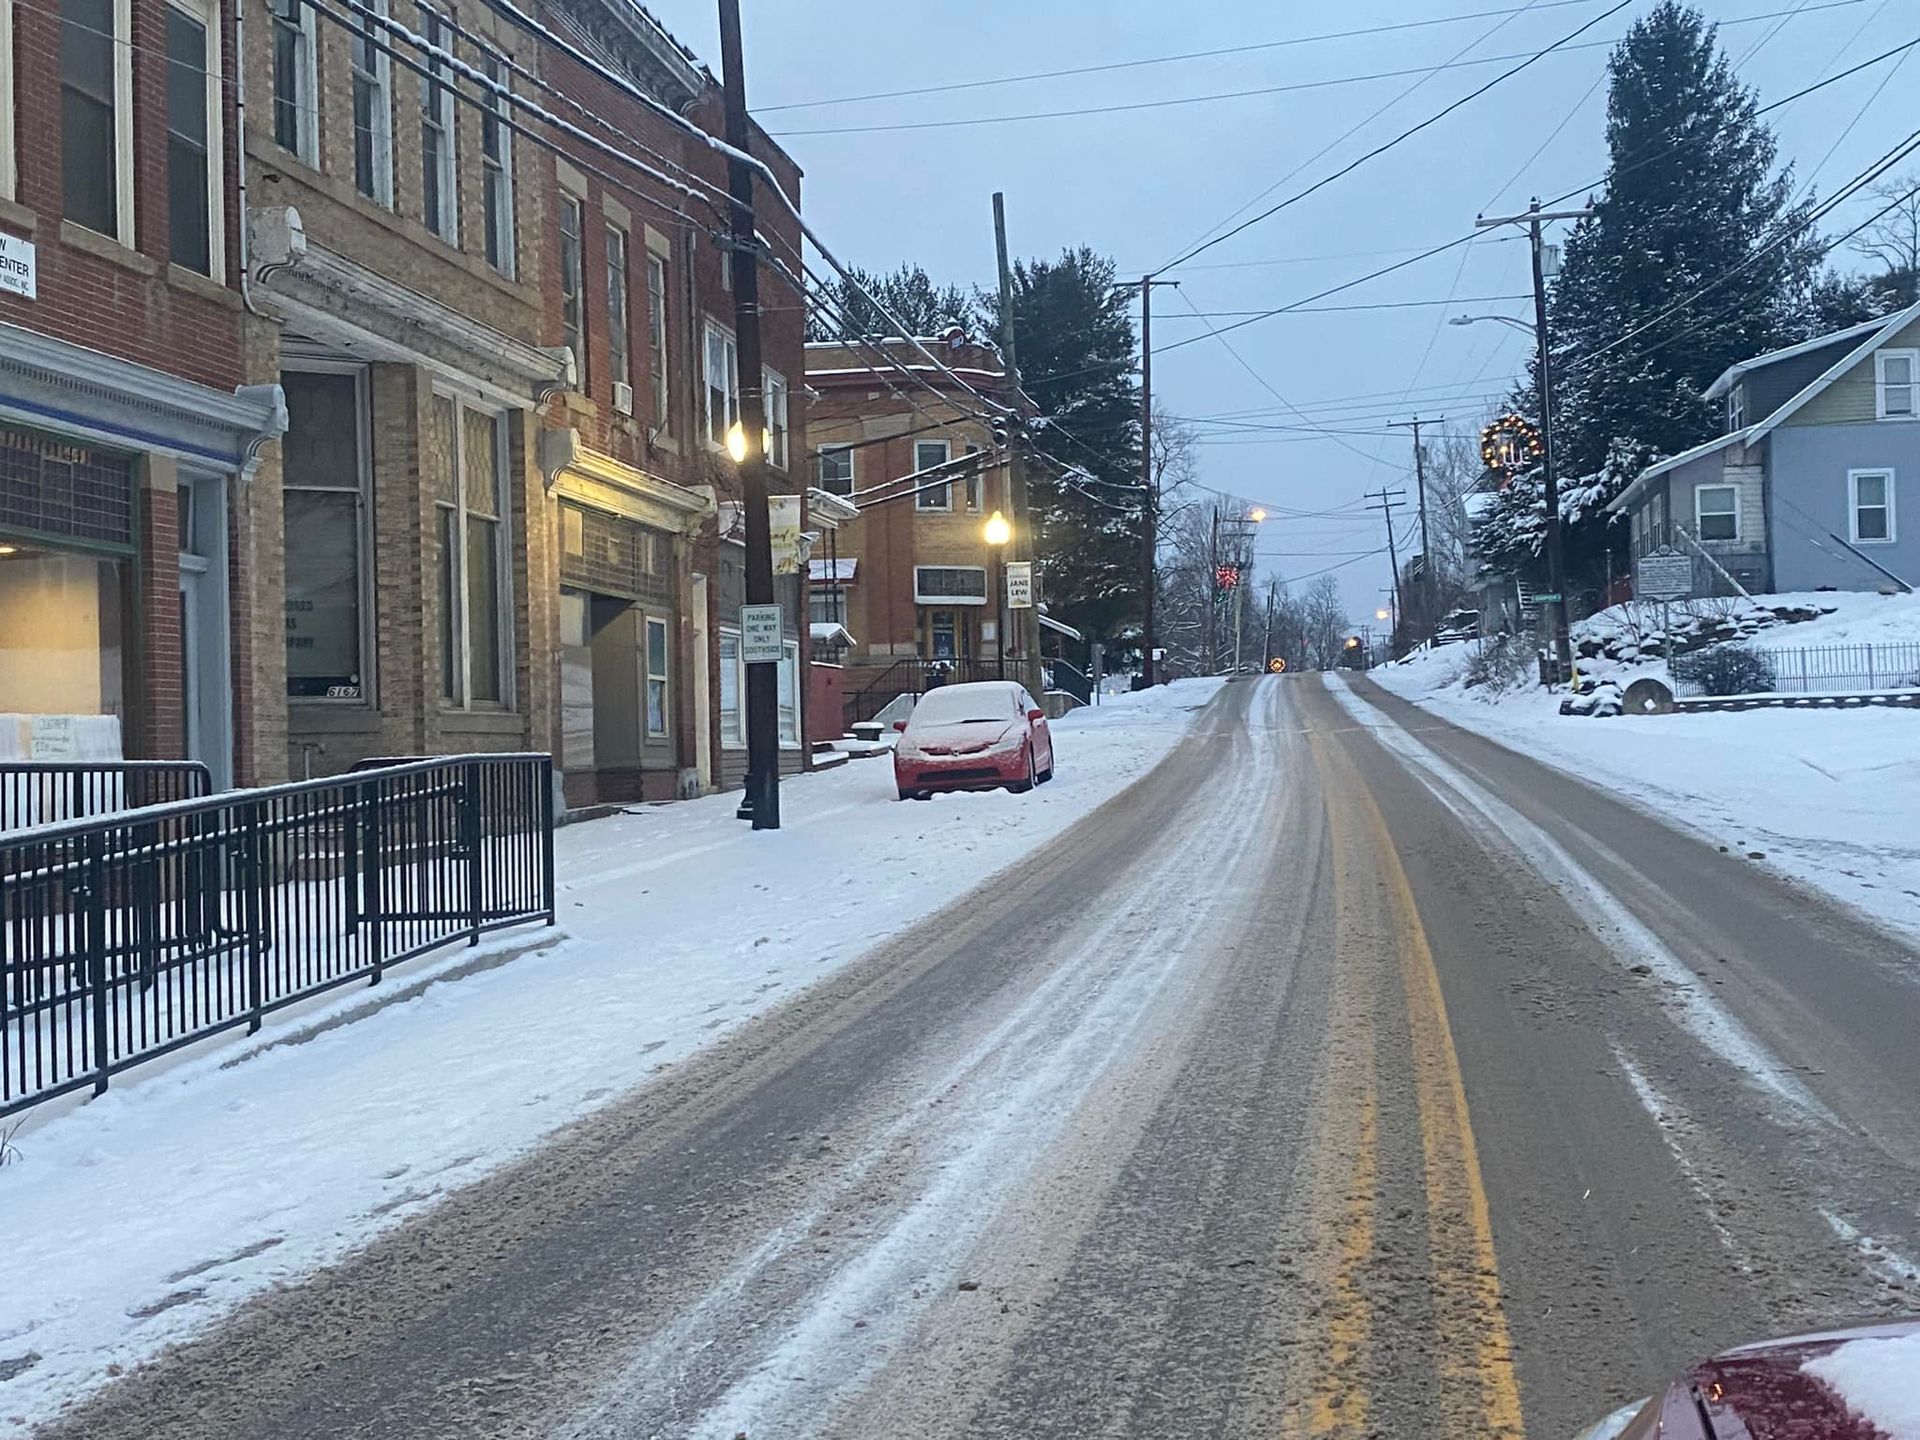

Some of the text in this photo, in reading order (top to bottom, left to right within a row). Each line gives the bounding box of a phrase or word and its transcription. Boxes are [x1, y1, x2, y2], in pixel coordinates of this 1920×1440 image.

[0, 255, 29, 277] ENTER
[747, 613, 776, 622] PARKING
[753, 635, 770, 643] ONLY
